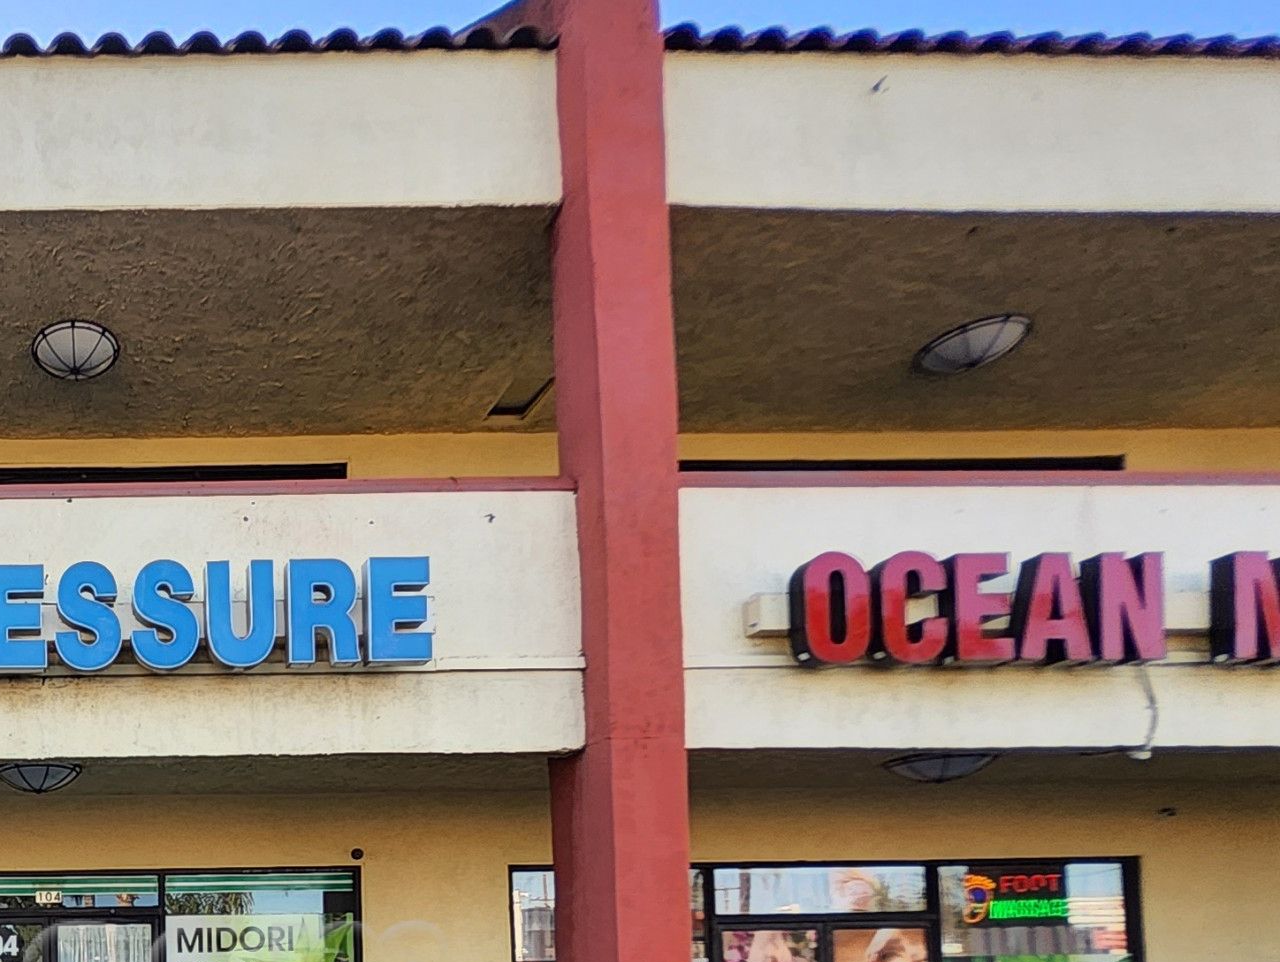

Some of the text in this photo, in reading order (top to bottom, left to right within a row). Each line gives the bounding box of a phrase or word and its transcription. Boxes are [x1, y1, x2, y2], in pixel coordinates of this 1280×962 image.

[800, 550, 1167, 664] OCEAN
[999, 874, 1061, 893] FOOT
[37, 892, 61, 901] 104
[176, 926, 295, 953] MIDORI
